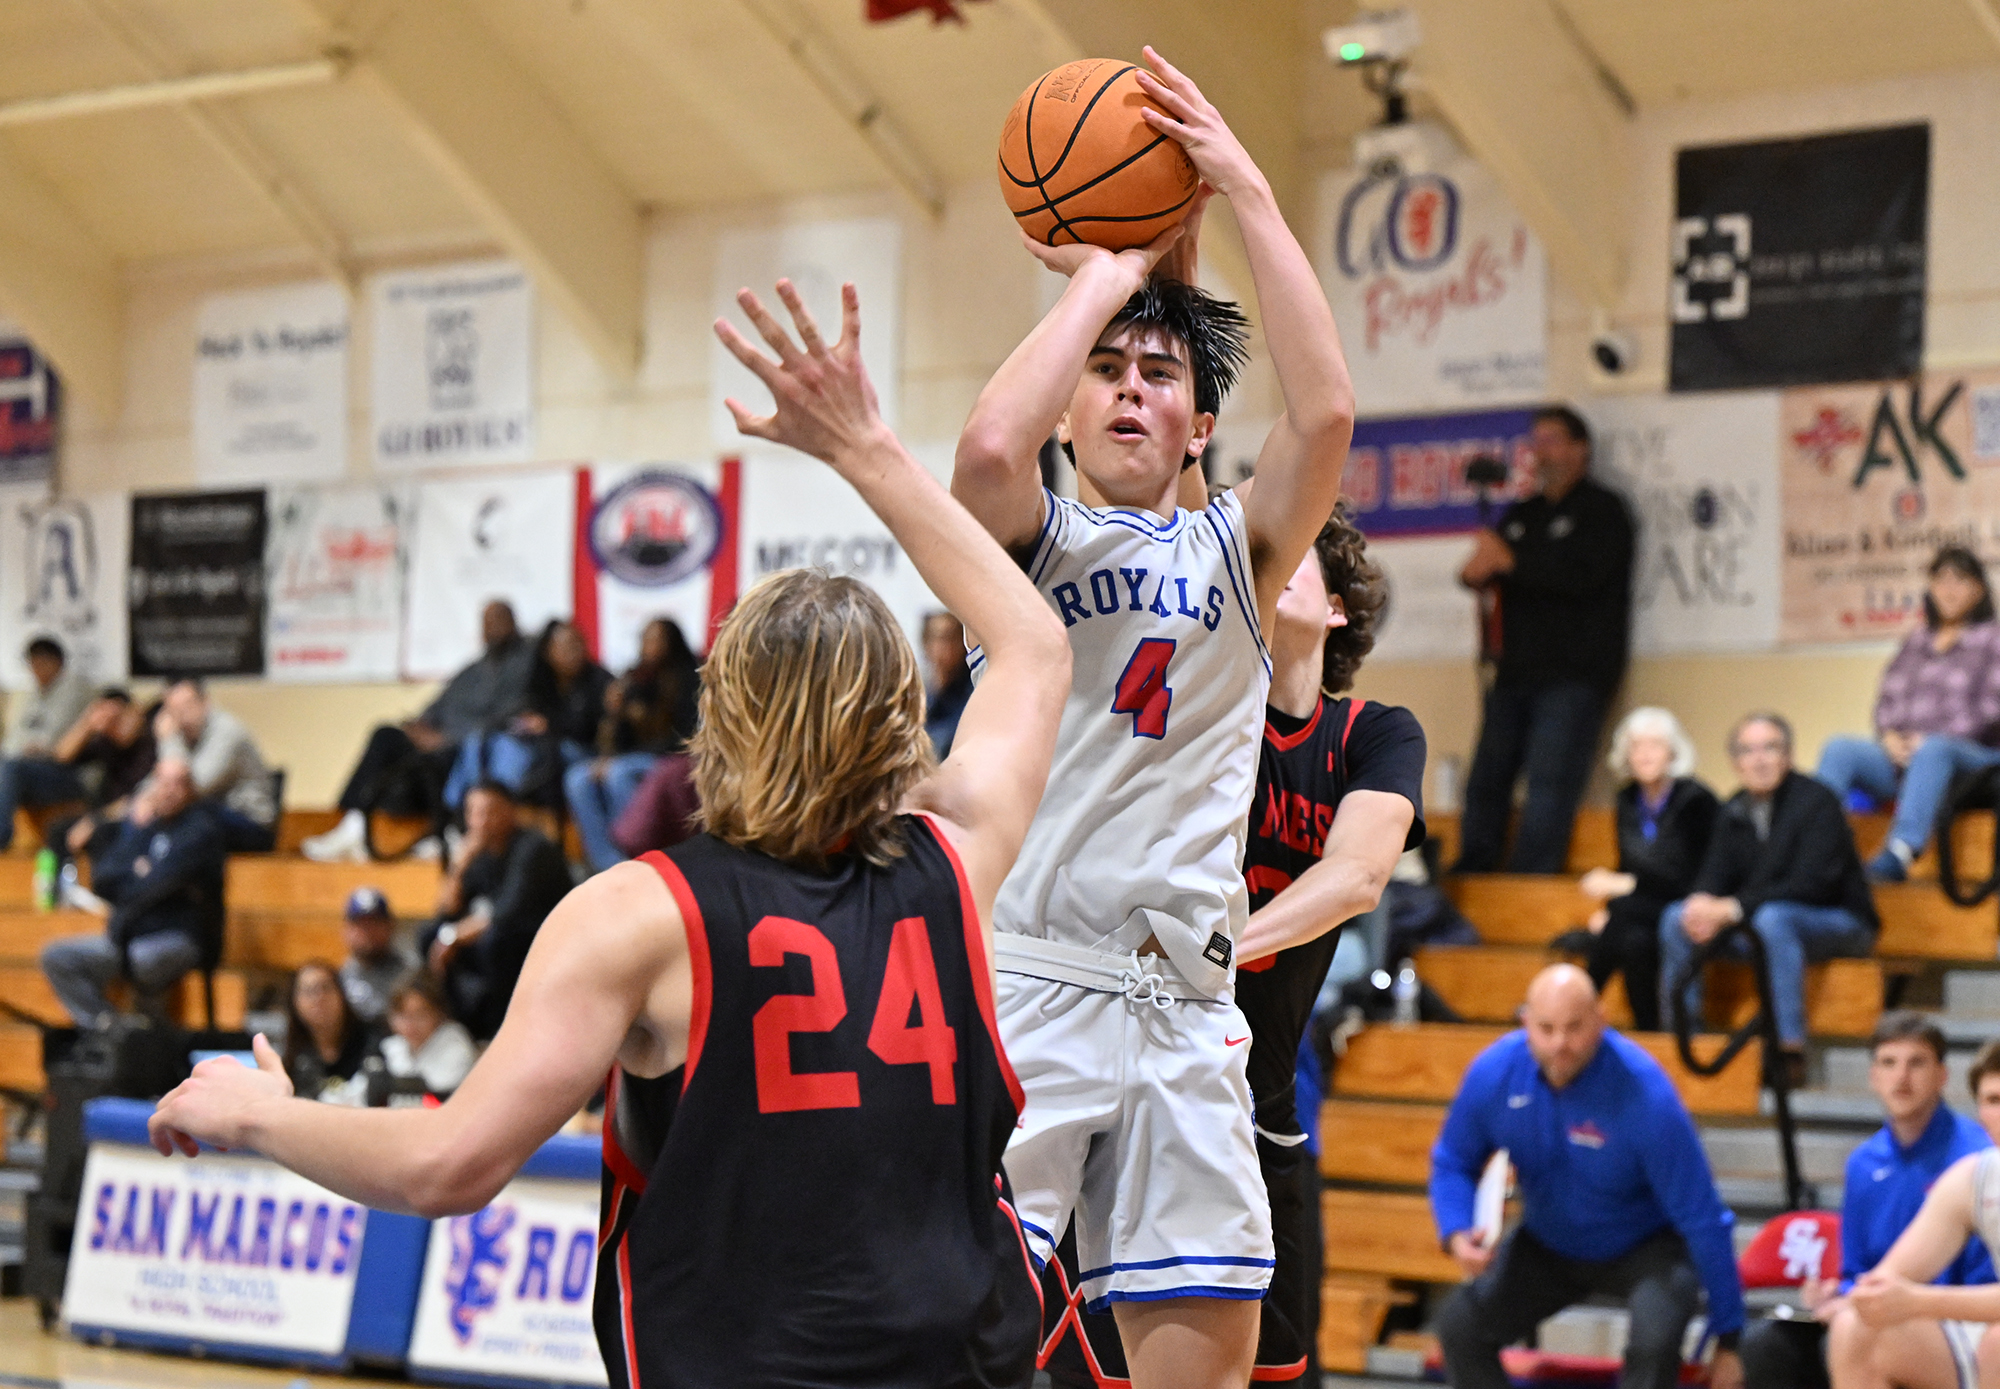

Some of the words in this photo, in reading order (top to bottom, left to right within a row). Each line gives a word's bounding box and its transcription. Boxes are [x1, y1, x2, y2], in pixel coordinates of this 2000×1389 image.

[1852, 380, 1968, 489] AK
[1052, 567, 1225, 632] ROYALS
[1110, 637, 1177, 740] 4
[1257, 782, 1334, 859] MES
[747, 915, 957, 1114] 24
[89, 1183, 175, 1257] SAN
[179, 1190, 357, 1276] MARCOS
[517, 1226, 597, 1302] RO
